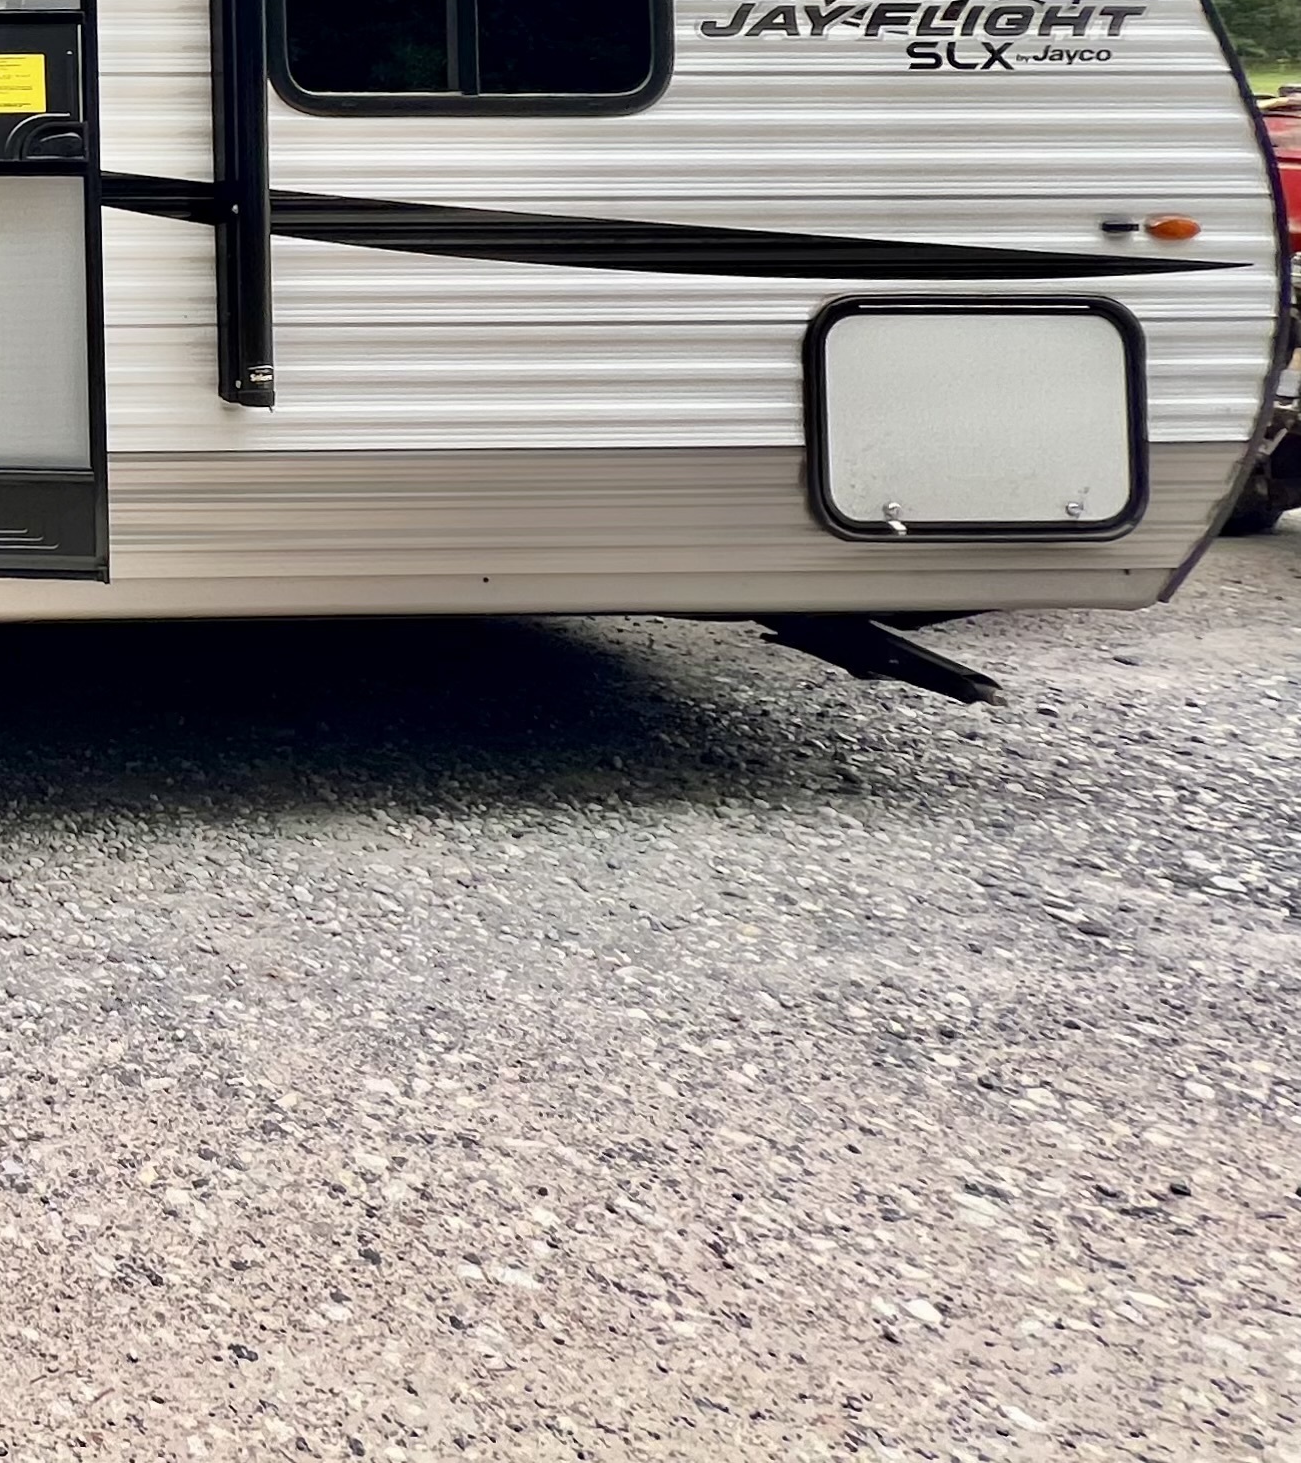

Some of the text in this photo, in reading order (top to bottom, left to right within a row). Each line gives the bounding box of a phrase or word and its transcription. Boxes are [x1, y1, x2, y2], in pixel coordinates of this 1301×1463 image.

[700, 2, 1146, 37] JAY FLIGHT
[906, 41, 1113, 70] SLX by Jayco
